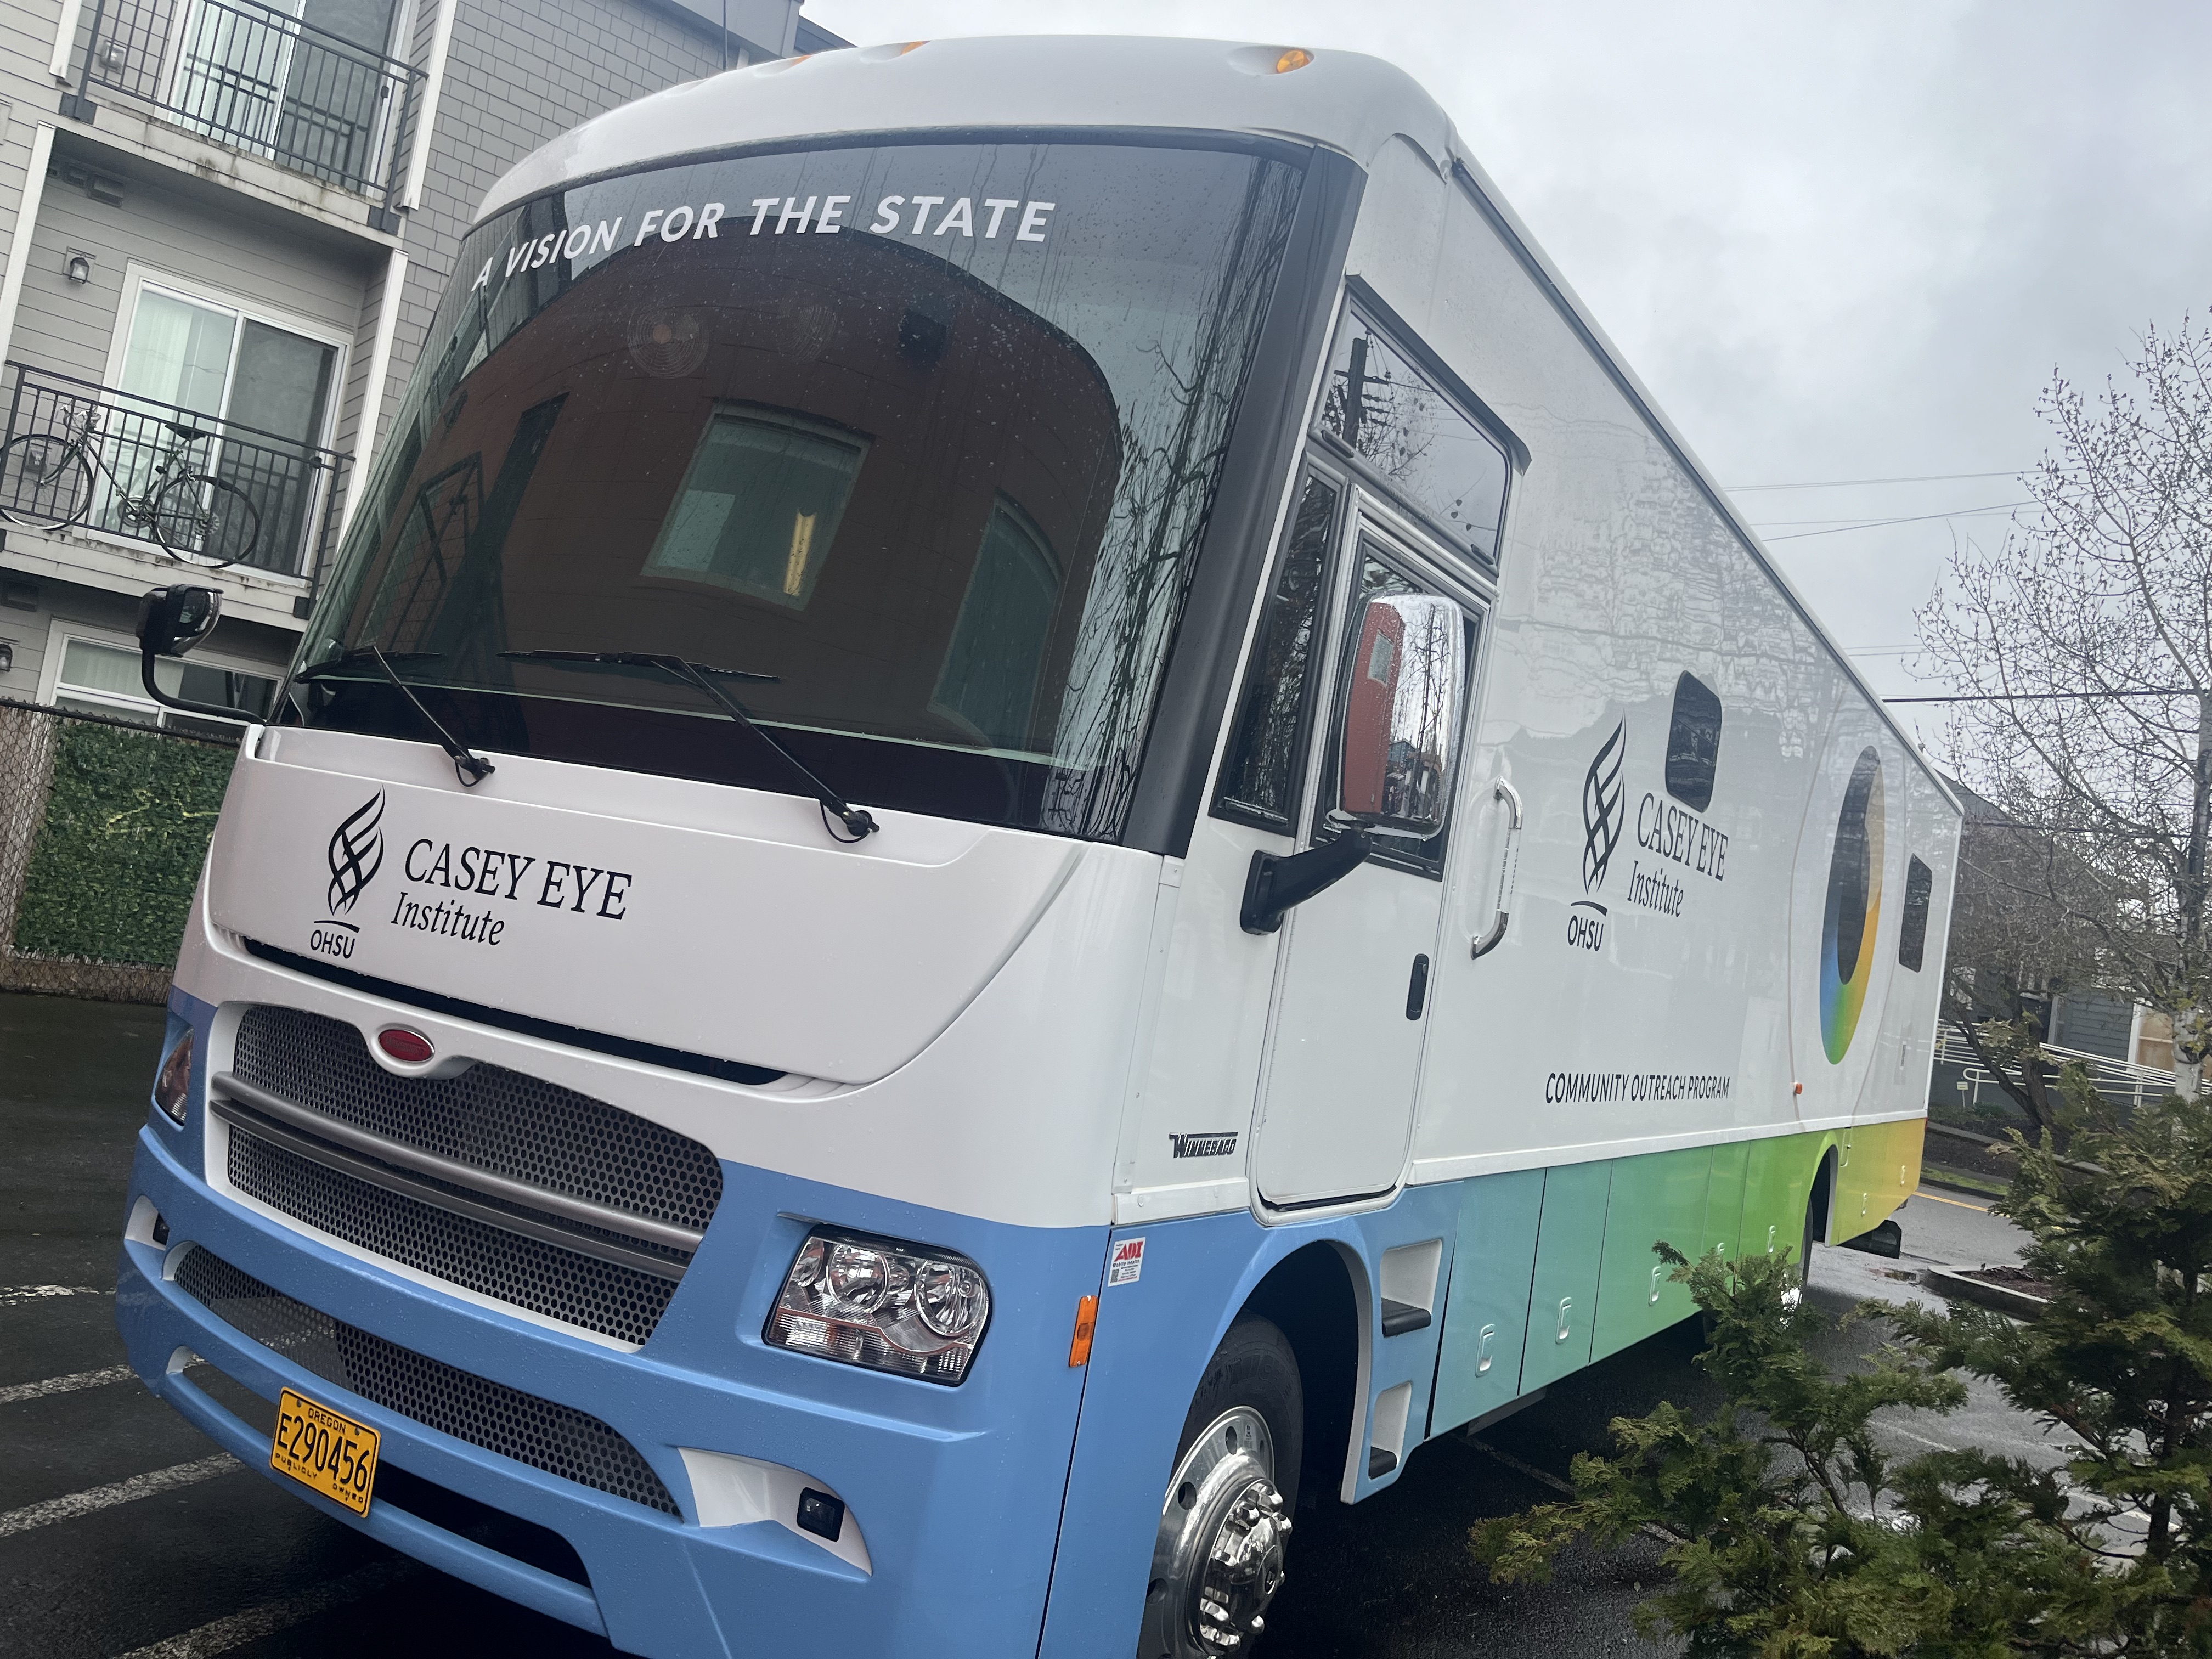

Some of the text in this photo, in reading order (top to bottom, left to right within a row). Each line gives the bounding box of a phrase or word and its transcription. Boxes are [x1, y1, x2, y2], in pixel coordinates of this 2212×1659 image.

[471, 195, 1056, 292] A VISION FOR THE STATE
[1637, 793, 1729, 882] CASEY EYE
[404, 839, 633, 921] CASEY EYE
[1627, 860, 1684, 918] Institute
[391, 891, 505, 946] Institute
[1567, 915, 1604, 952] OHSU
[310, 929, 356, 959] OHSU
[1545, 1073, 1730, 1104] COMMUNITY OUTREACH PROGRAM
[1113, 1241, 1144, 1262] ADI
[308, 1407, 346, 1435] OREGON
[275, 1452, 318, 1480] PUBLICLY
[277, 1413, 370, 1492] E290456
[332, 1482, 364, 1504] OWNED
